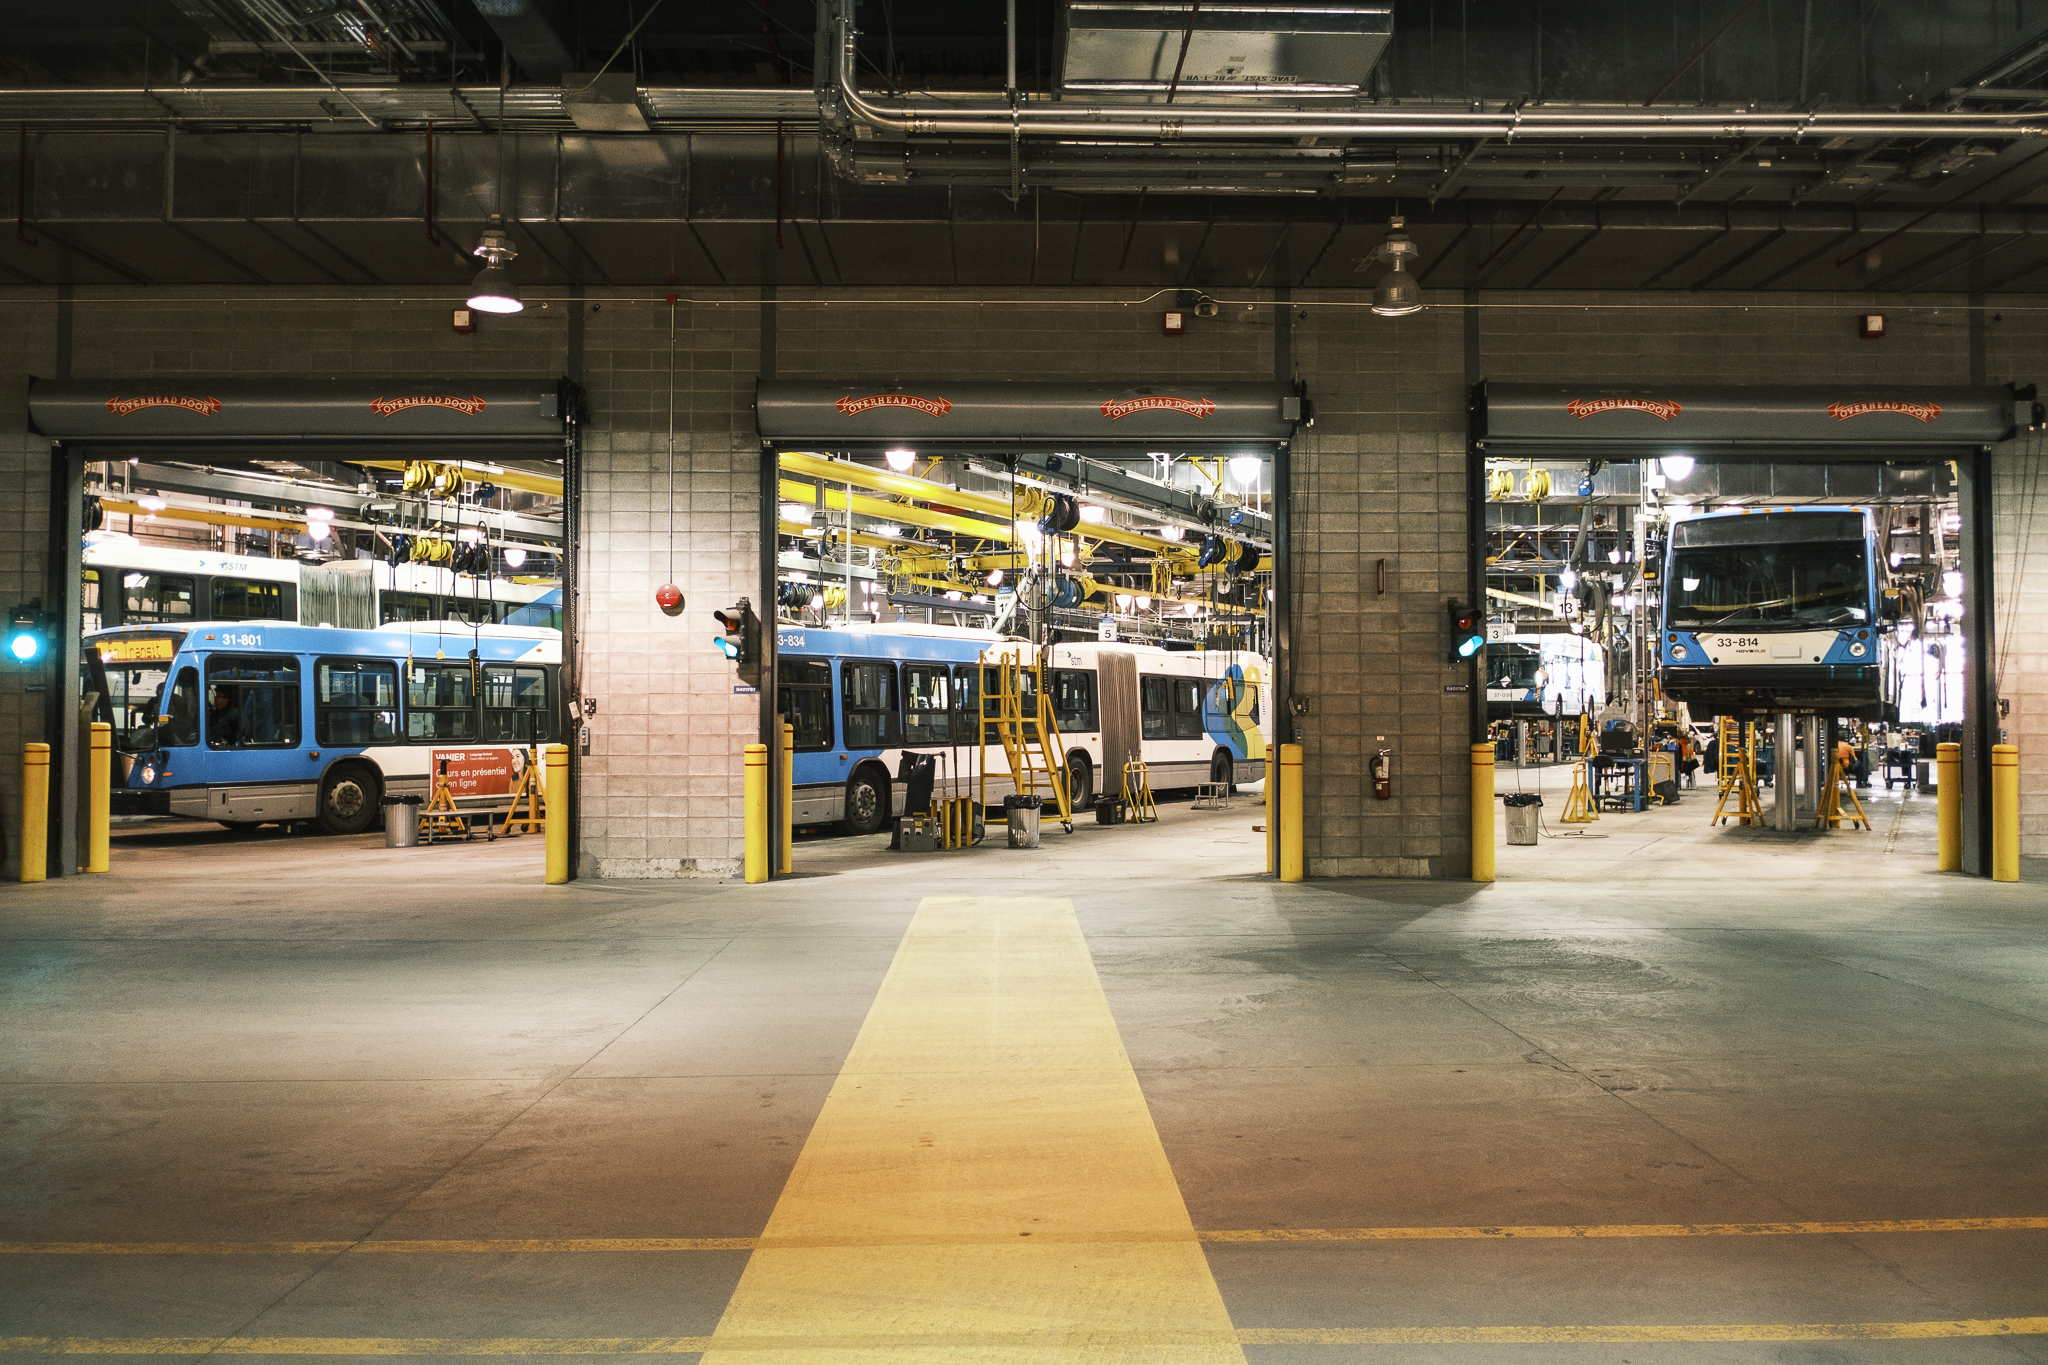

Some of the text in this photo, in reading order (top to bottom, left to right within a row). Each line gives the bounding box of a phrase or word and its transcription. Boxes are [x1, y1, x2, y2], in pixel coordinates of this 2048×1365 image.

[120, 396, 209, 413] OVERHEAD DOOR
[383, 396, 473, 413] OVERHEAD DOOR
[849, 396, 939, 414] OVERHEAD DOOR
[1112, 398, 1203, 416] OVERHEAD DOOR
[1579, 399, 1668, 417] OVERHEAD DOOR
[1840, 401, 1928, 419] OVERHEAD DOOR
[228, 562, 248, 571] STM
[1559, 602, 1573, 614] 13
[222, 633, 262, 646] 31-801
[1104, 629, 1112, 638] 5
[1492, 630, 1499, 639] 3
[777, 634, 805, 647] 3-834
[1717, 638, 1758, 647] 33-814
[1070, 656, 1083, 666] stm
[435, 753, 465, 761] VANIER
[435, 768, 459, 778] Curs
[472, 766, 507, 778] présentiel
[459, 778, 477, 789] ligne
